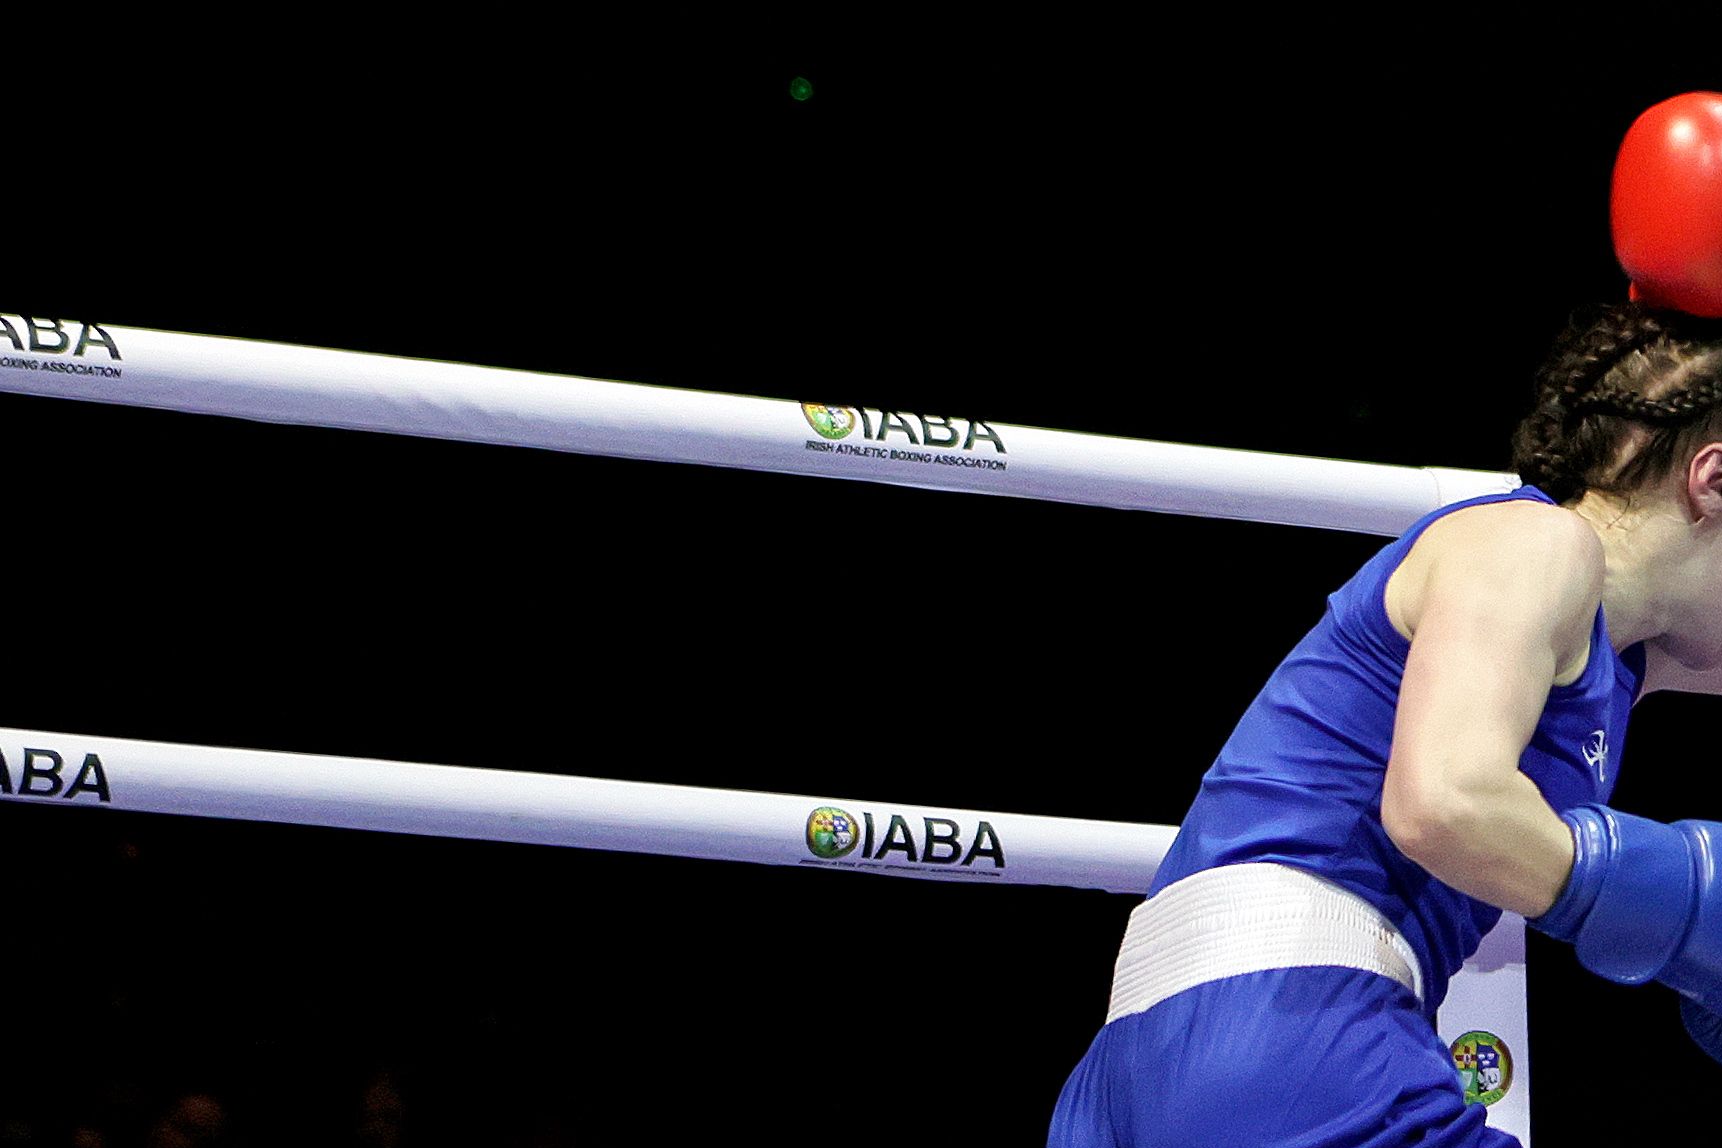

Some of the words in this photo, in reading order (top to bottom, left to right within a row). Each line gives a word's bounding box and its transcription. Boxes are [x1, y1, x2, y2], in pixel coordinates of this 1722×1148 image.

[40, 360, 122, 378] ASSOCIATION
[855, 407, 1007, 454] IABA
[805, 440, 834, 453] IRISH
[835, 444, 888, 459] ATHLETIC
[890, 450, 932, 464] BOXING
[934, 455, 1007, 471] ASSOCIATION
[0, 748, 111, 802] BA
[861, 811, 1006, 868] IABA
